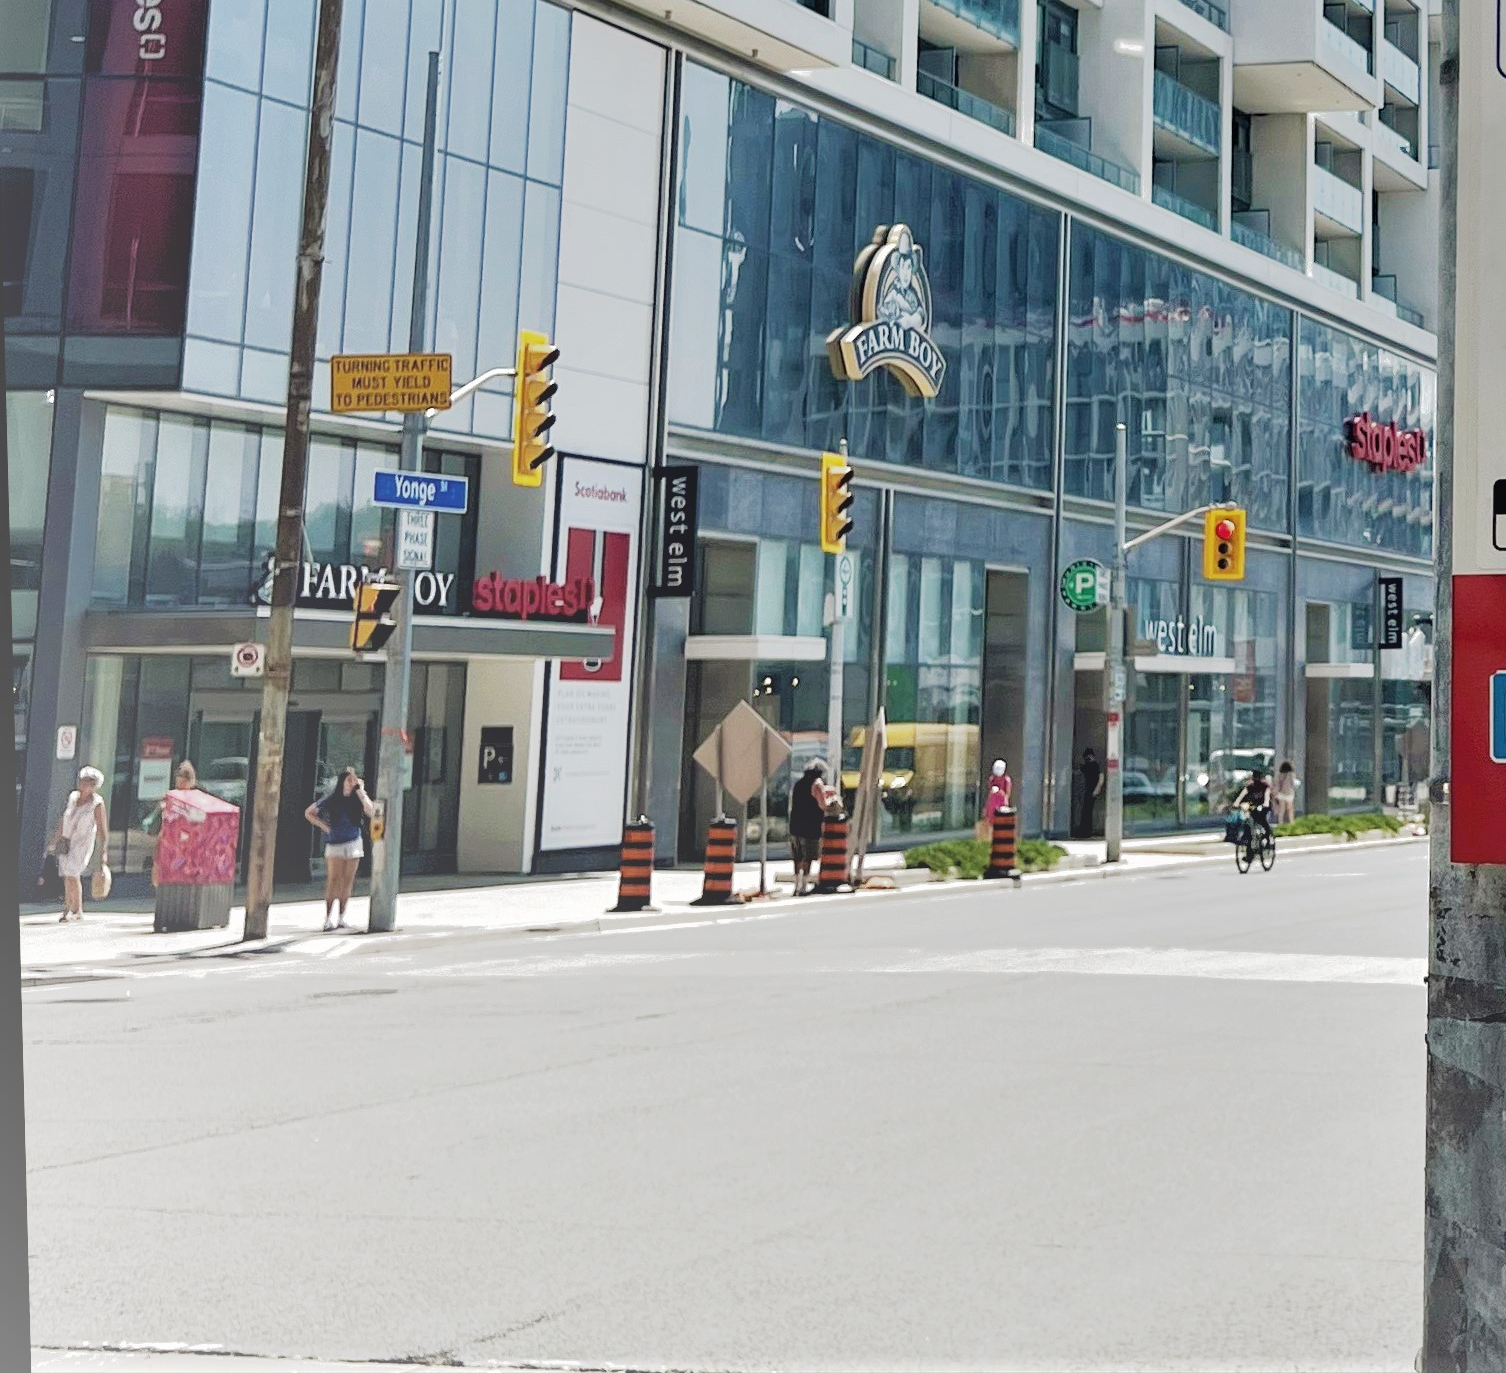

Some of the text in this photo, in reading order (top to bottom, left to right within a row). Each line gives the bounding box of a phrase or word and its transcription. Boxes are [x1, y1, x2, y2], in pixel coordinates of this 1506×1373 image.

[334, 358, 449, 374] TURNING TRAFFIC
[857, 325, 942, 381] FARM BOY
[352, 375, 431, 390] MUST YIELD
[336, 391, 447, 407] TO PEDESTRIANS
[1351, 412, 1417, 473] staples
[394, 474, 436, 506] Yonge
[575, 481, 627, 502] Scotiabank
[667, 476, 688, 587] west elm
[474, 572, 582, 620] staples
[1075, 573, 1094, 594] P
[1387, 583, 1399, 644] west elm
[1144, 614, 1218, 656] west elm
[484, 746, 496, 769] P
